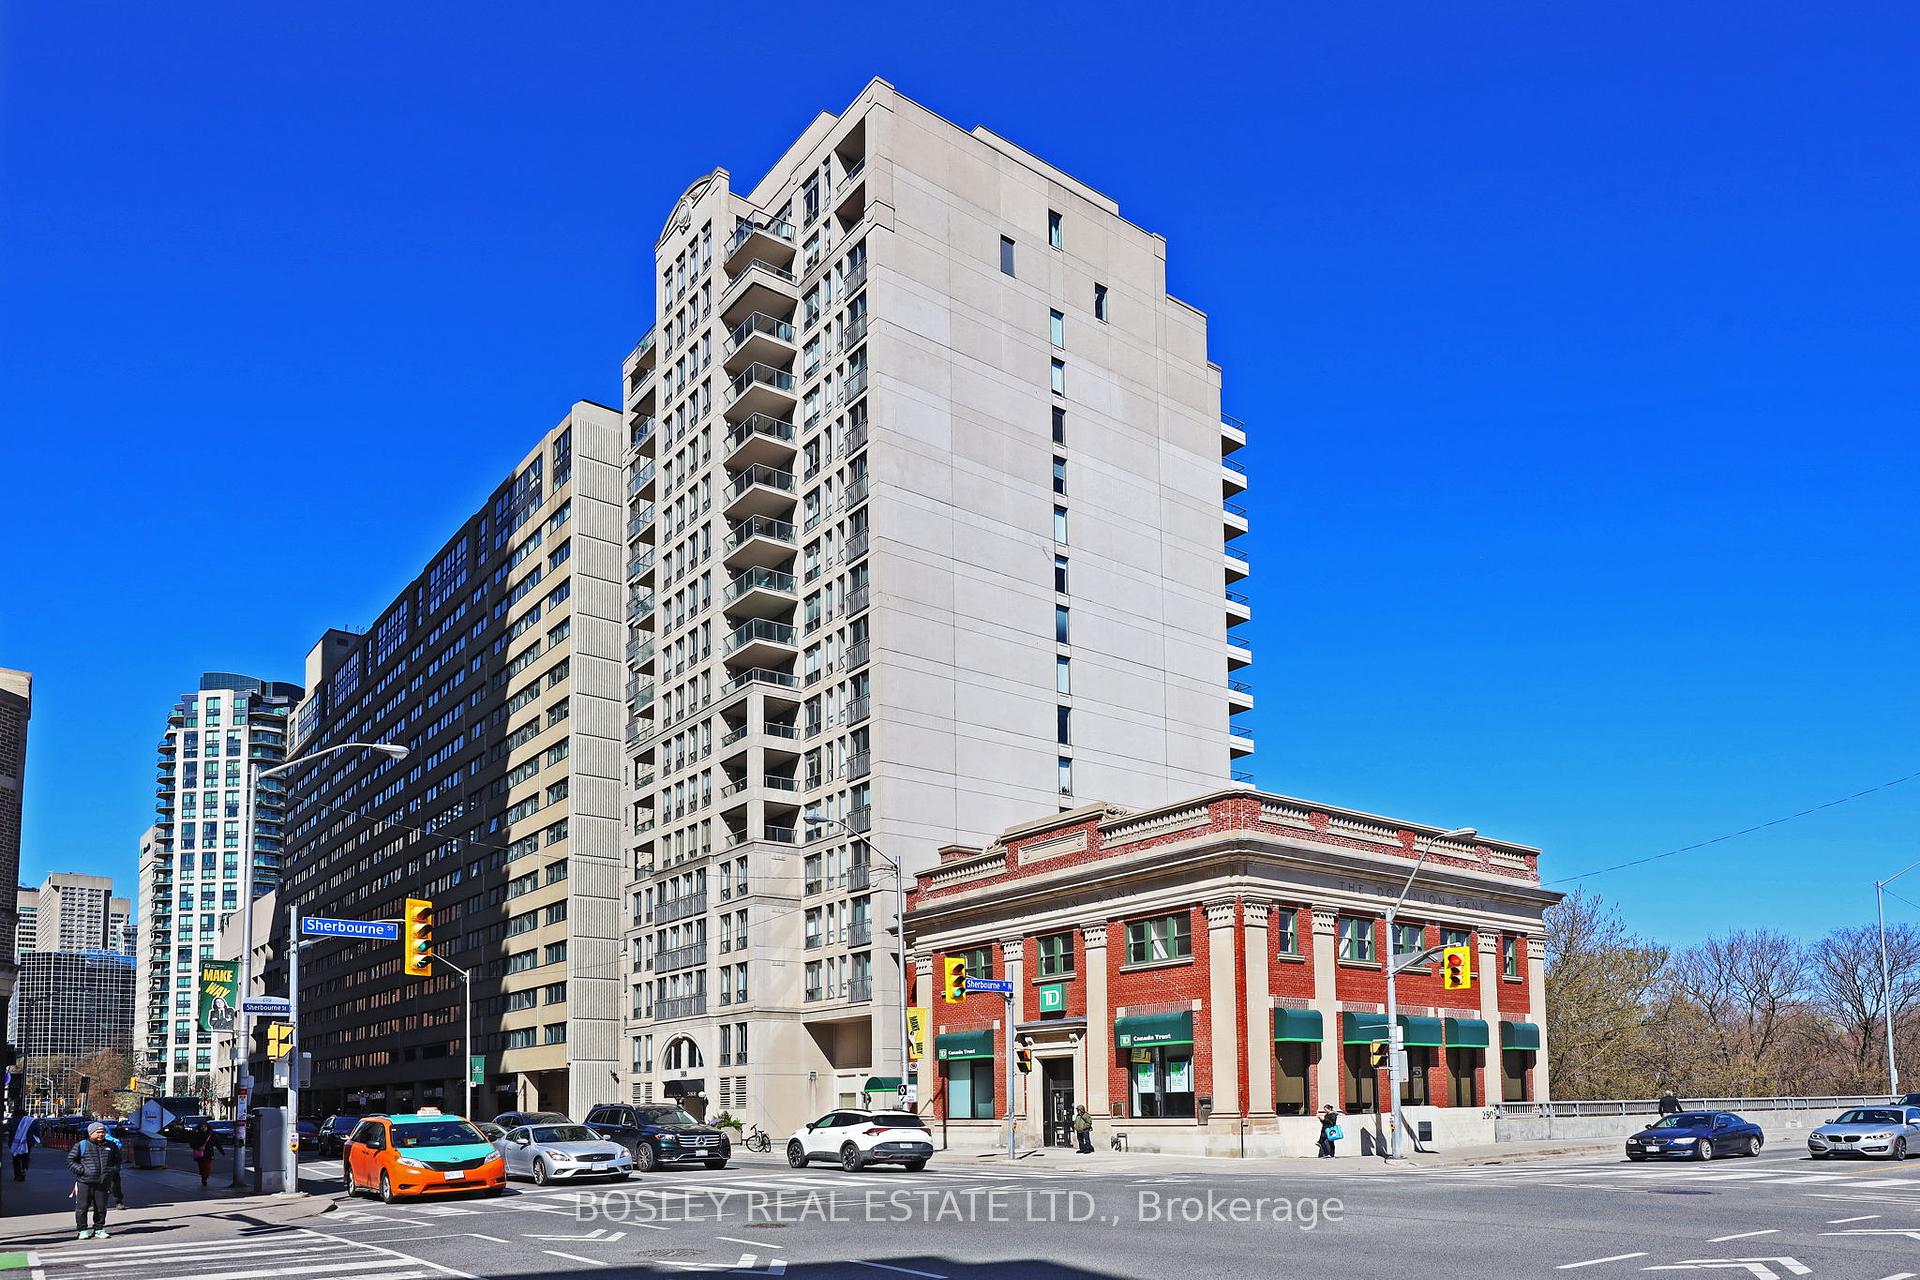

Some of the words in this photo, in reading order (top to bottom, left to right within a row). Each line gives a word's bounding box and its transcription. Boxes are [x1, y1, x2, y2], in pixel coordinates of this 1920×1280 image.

[1338, 881, 1364, 894] THE
[1455, 898, 1487, 912] BANK
[307, 919, 384, 934] Sherbourne
[203, 969, 233, 982] MAKE
[205, 982, 231, 998] WAY
[967, 980, 1000, 989] Sherbourne
[1042, 990, 1060, 1006] TD
